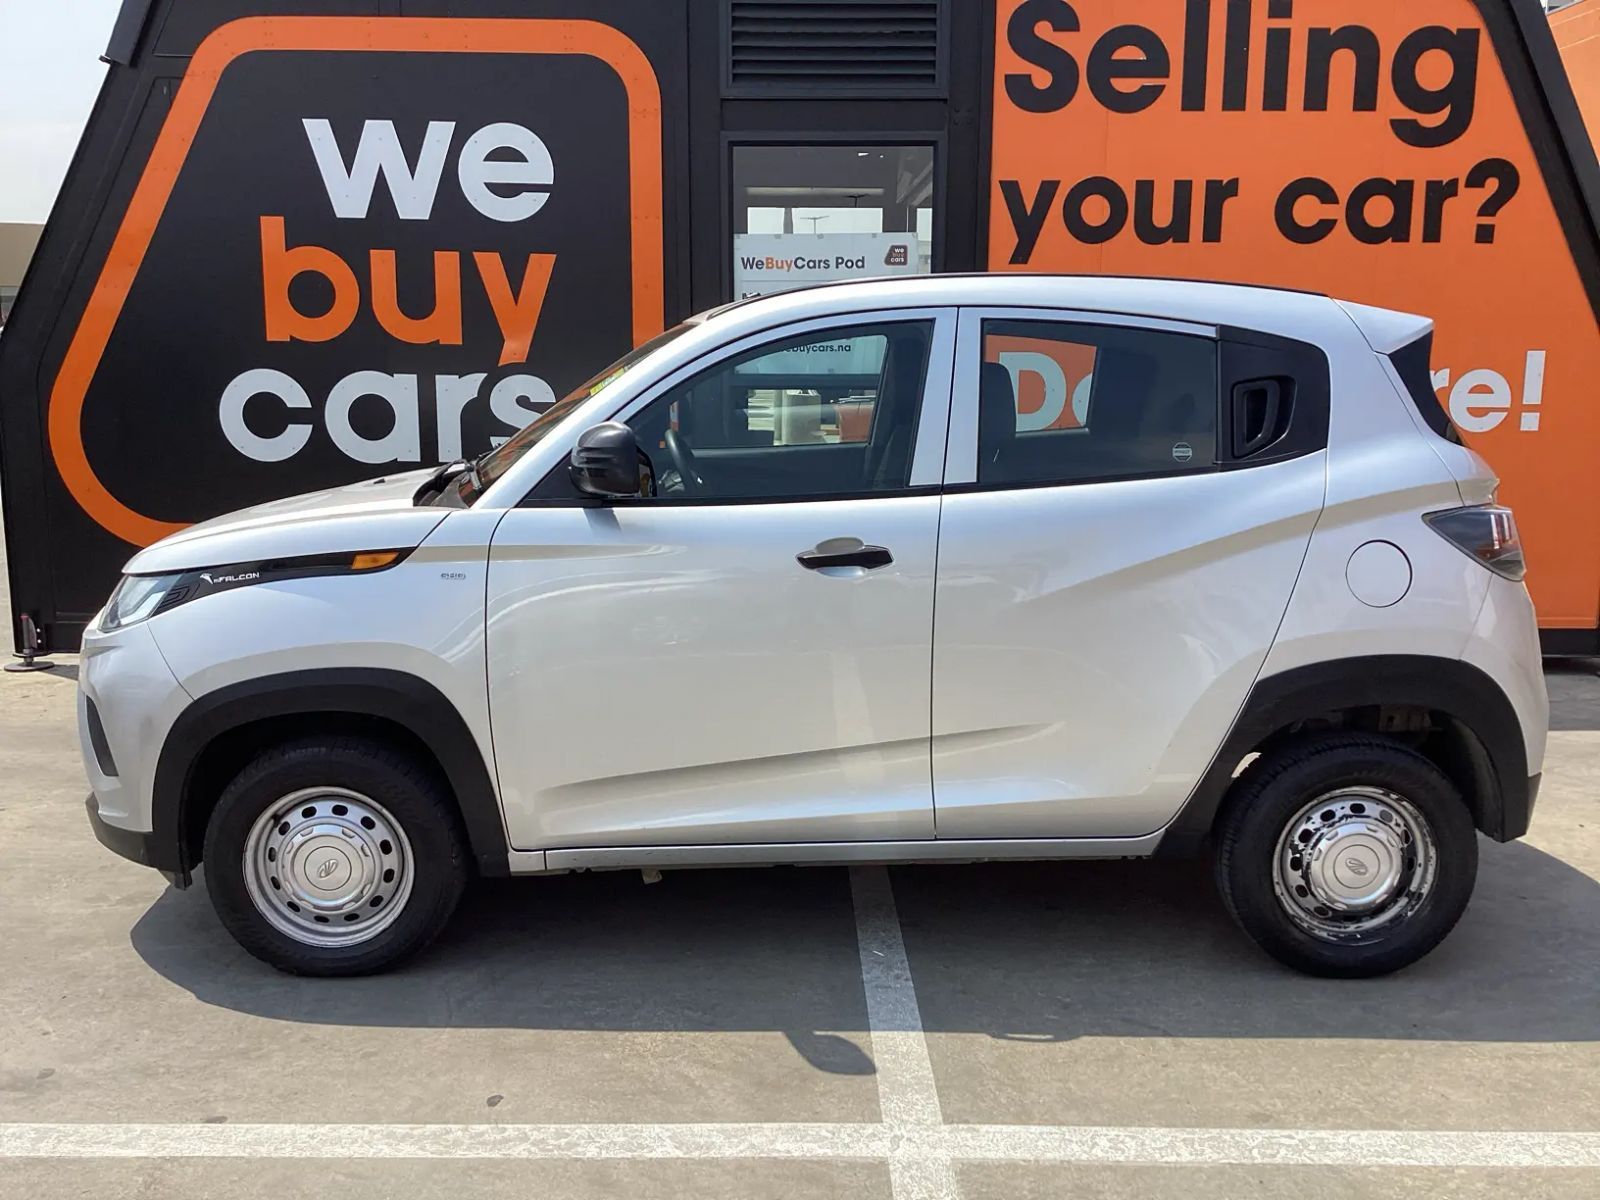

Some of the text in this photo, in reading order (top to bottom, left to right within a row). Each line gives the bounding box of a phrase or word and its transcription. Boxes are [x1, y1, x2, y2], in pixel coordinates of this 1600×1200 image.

[1004, 0, 1481, 148] Selling
[302, 119, 555, 222] we
[999, 157, 1520, 264] your car?
[259, 215, 557, 365] buy
[741, 256, 865, 272] WeBuyCars Pod
[783, 343, 852, 354] buycars.na
[218, 368, 557, 463] cars
